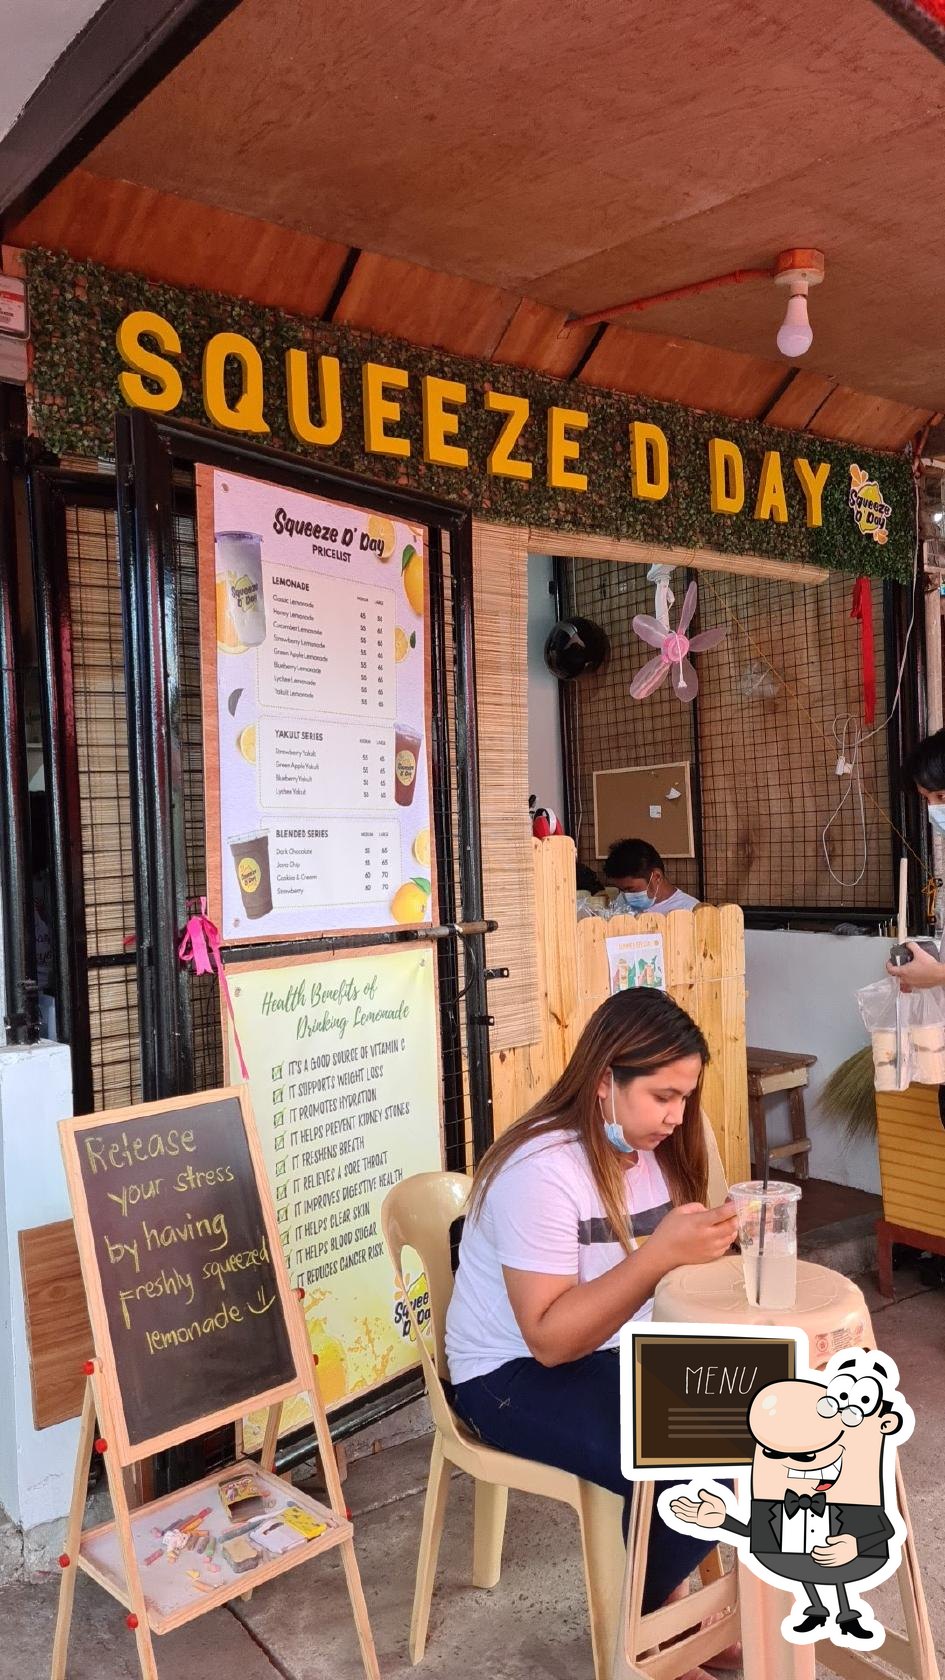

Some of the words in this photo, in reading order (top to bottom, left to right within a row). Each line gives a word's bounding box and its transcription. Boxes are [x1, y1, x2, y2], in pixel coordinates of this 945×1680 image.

[116, 310, 588, 492] SQUEEZE
[629, 421, 669, 501] D
[709, 438, 831, 528] DAY
[849, 489, 891, 516] Squeeze
[866, 512, 886, 530] Day
[273, 508, 339, 543] Squeeze
[360, 532, 385, 557] Day
[312, 544, 352, 563] PRICELIST
[272, 576, 310, 592] LEMONADE
[275, 729, 301, 740] YAKULT
[301, 731, 324, 742] SERIES
[275, 829, 306, 838] BLENDED
[307, 829, 329, 838] SERIES
[289, 847, 313, 855] Chocolate
[381, 871, 389, 879] 70
[381, 883, 389, 891] 70
[261, 978, 307, 1017] Health
[310, 976, 360, 1008] Benefits
[363, 974, 378, 1001] of
[296, 1010, 350, 1040] Drinking
[352, 999, 410, 1028] Lemonade
[288, 1060, 302, 1077] IT'S
[304, 1058, 309, 1073] A
[311, 1053, 331, 1072] GOOD
[333, 1047, 359, 1067] SOURCE
[360, 1045, 369, 1060] OF
[370, 1039, 399, 1059] VITAMIN
[400, 1037, 406, 1052] C
[288, 1083, 297, 1100] IT
[298, 1074, 336, 1098] SUPPORTS
[337, 1066, 365, 1088] WEIGHT
[366, 1064, 384, 1082] LOSS
[289, 1107, 298, 1124] IT
[299, 1097, 338, 1121] PROMOTES
[339, 1087, 378, 1110] HYDRATION
[290, 1130, 299, 1147] IT
[300, 1124, 324, 1144] HELPS
[325, 1114, 357, 1138] PREVENT
[358, 1108, 383, 1128] KIDNEY
[384, 1101, 411, 1121] STONES
[84, 1128, 197, 1175] Release
[292, 1154, 300, 1171] IT
[302, 1143, 338, 1168] FRESHENS
[339, 1135, 366, 1156] BREATH
[107, 1177, 165, 1217] your
[173, 1165, 235, 1193] stress
[293, 1177, 302, 1195] IT
[303, 1167, 336, 1191] RELIEVES
[337, 1165, 342, 1181] A
[344, 1158, 361, 1178] SORE
[361, 1150, 389, 1171] THROAT
[294, 1201, 303, 1218] IT
[304, 1189, 341, 1215] IMPROVES
[342, 1176, 378, 1202] DIGESTIVE
[378, 1167, 404, 1189] HEALTH
[295, 1225, 303, 1242] IT
[304, 1216, 328, 1239] HELPS
[329, 1207, 352, 1230] CLEAR
[352, 1200, 371, 1221] SKIN
[104, 1234, 140, 1274] by
[142, 1212, 229, 1252] having
[296, 1248, 304, 1266] IT
[305, 1240, 329, 1263] HELPS
[330, 1230, 353, 1252] BLOOD
[354, 1221, 378, 1243] SUGAR
[119, 1267, 195, 1330] Freshly
[202, 1235, 271, 1291] squeezed
[296, 1272, 305, 1289] IT
[306, 1259, 339, 1287] REDUCES
[339, 1247, 368, 1273] CANCER
[367, 1240, 385, 1262] RISK
[145, 1302, 244, 1355] lemonade
[416, 1307, 431, 1326] Da
